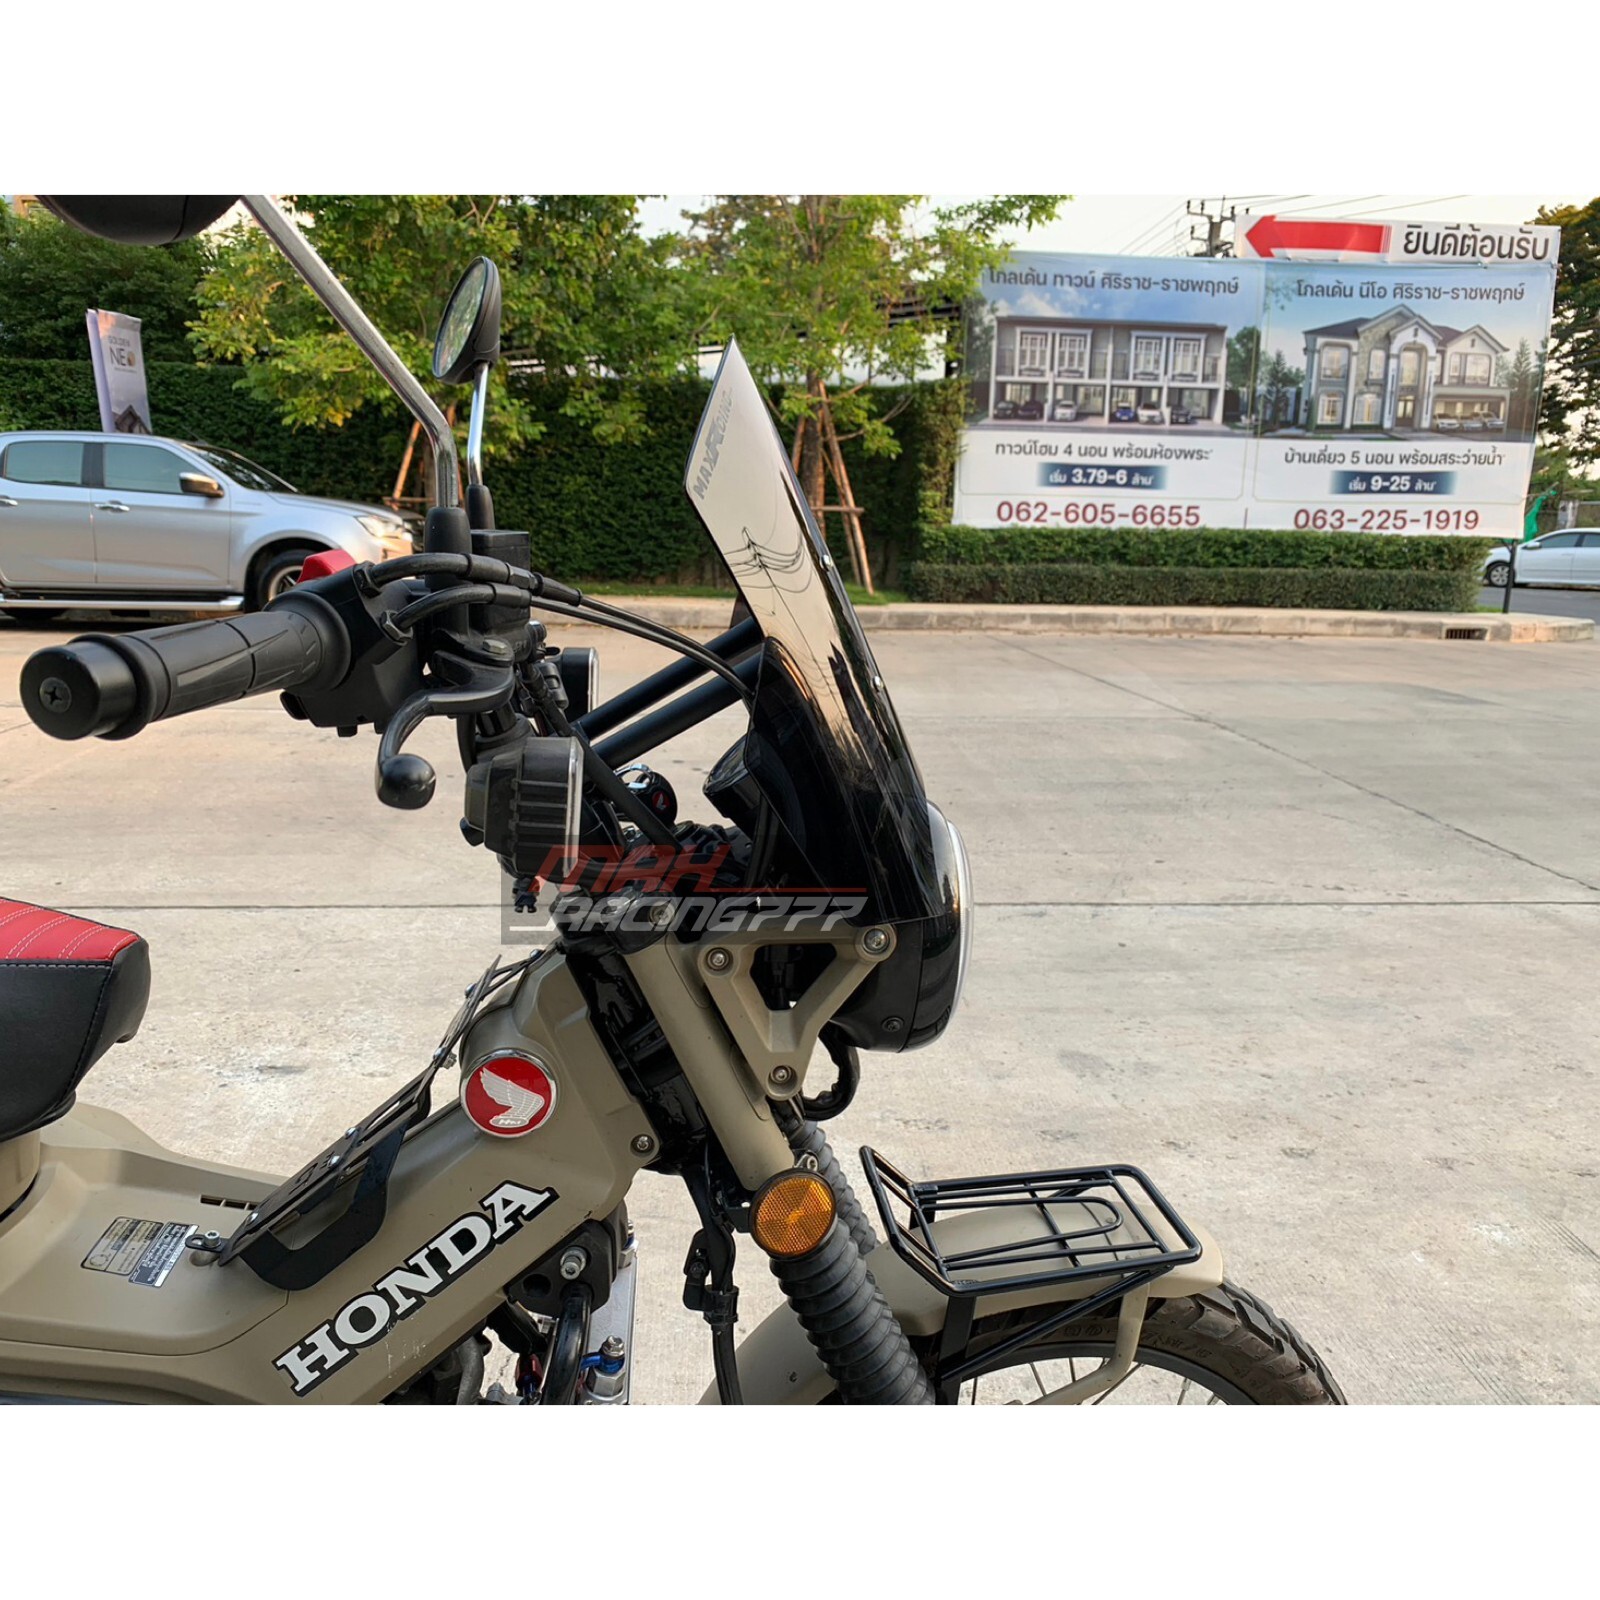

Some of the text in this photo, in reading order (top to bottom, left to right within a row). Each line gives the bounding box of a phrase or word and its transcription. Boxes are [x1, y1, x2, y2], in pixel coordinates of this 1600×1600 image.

[1403, 223, 1551, 261] ยินดีต้อนรับ
[1052, 270, 1097, 289] ทาวน์
[1100, 271, 1239, 297] ศิริราช-ราชพฤกษ์
[1296, 279, 1526, 304] โกลเด้น นีโอ ศิริราช-ราชพฤกษ์
[995, 439, 1059, 457] ทาวน์โฮม
[1063, 444, 1073, 457] 4
[1077, 445, 1108, 458] นอน
[1284, 445, 1346, 465] บ้านเดี่ยว
[1350, 450, 1360, 465] 5
[1365, 452, 1394, 465] นอน
[1071, 467, 1128, 485] 3.79-6
[1370, 475, 1411, 491] 9-25
[996, 500, 1201, 526] 062-605-6655
[1293, 508, 1480, 530] 063-225-1919
[273, 1181, 558, 1395] HONDA
